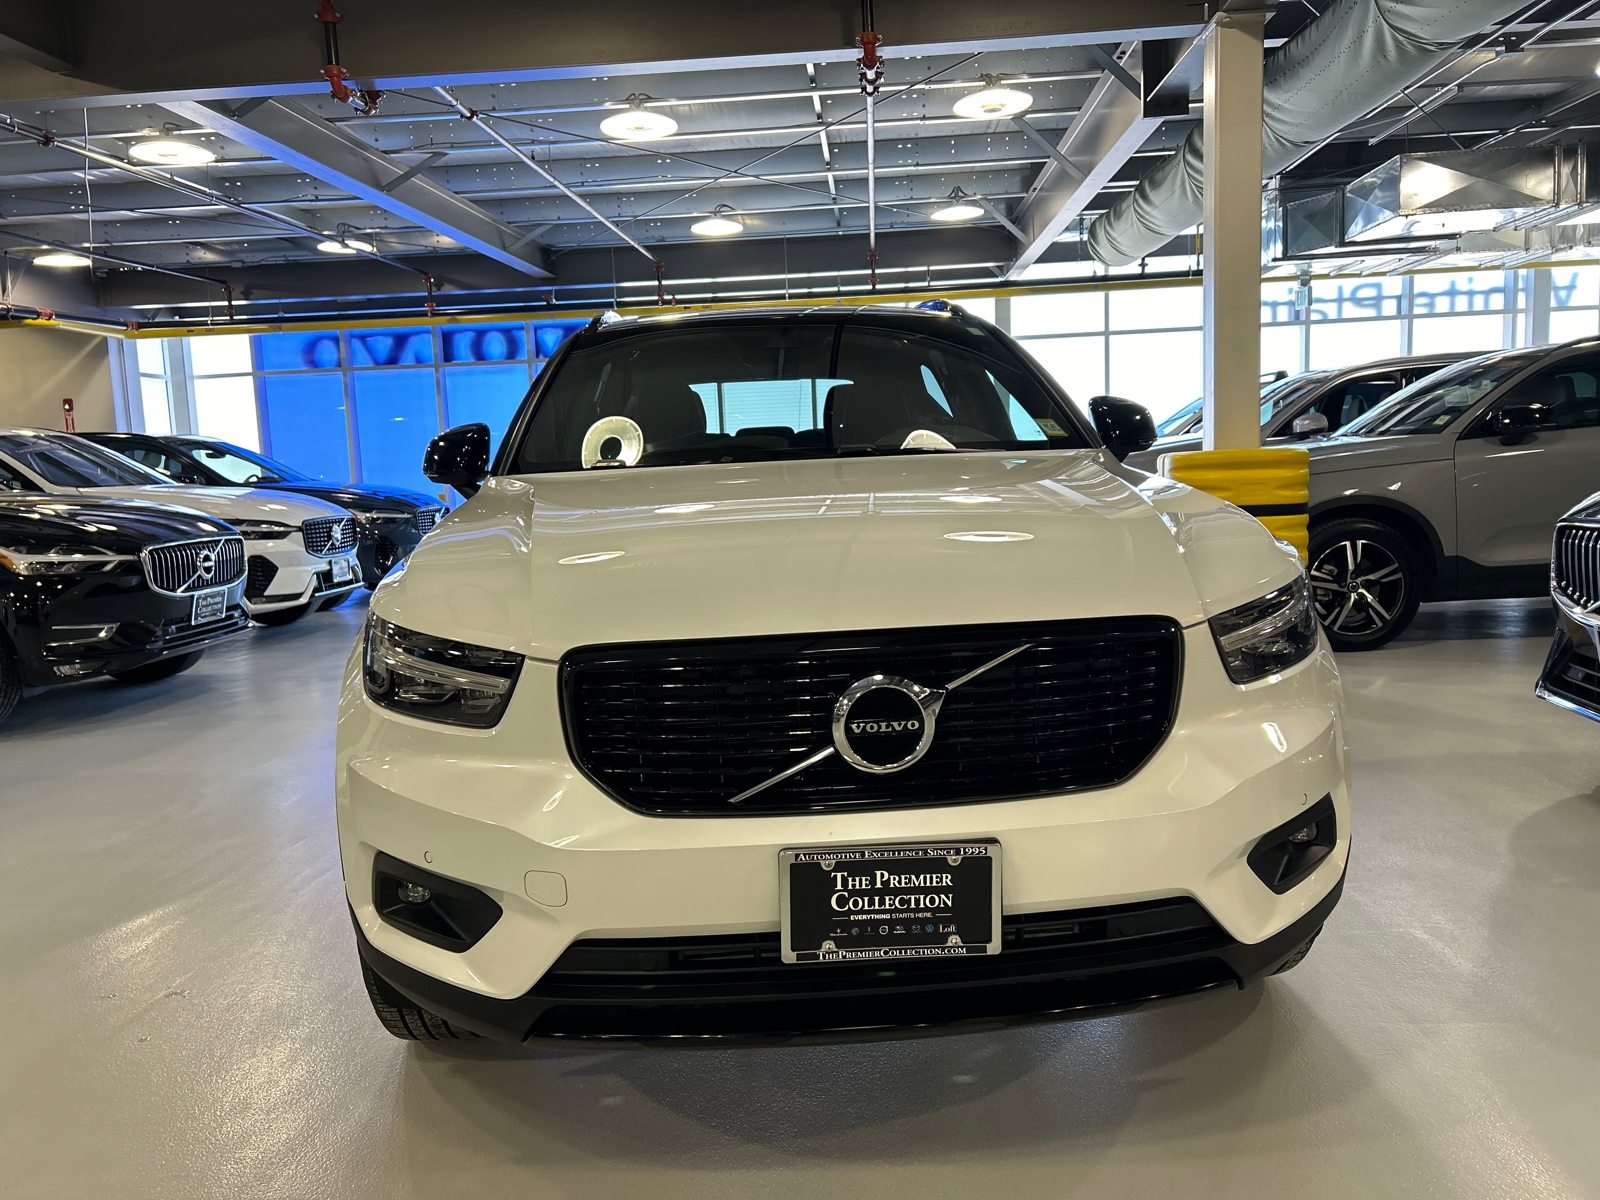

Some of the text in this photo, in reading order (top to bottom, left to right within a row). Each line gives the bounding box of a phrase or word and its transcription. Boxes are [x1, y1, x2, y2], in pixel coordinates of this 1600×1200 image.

[850, 720, 920, 733] VOLVO
[797, 846, 986, 861] AUTOMOTIVE EXCELLENCE SINCE 1995
[831, 870, 953, 890] THE PREMIER
[830, 891, 953, 912] COLLECTION
[939, 924, 956, 933] Loft
[817, 947, 967, 960] THEPREMIERCOLLECTION.COM
